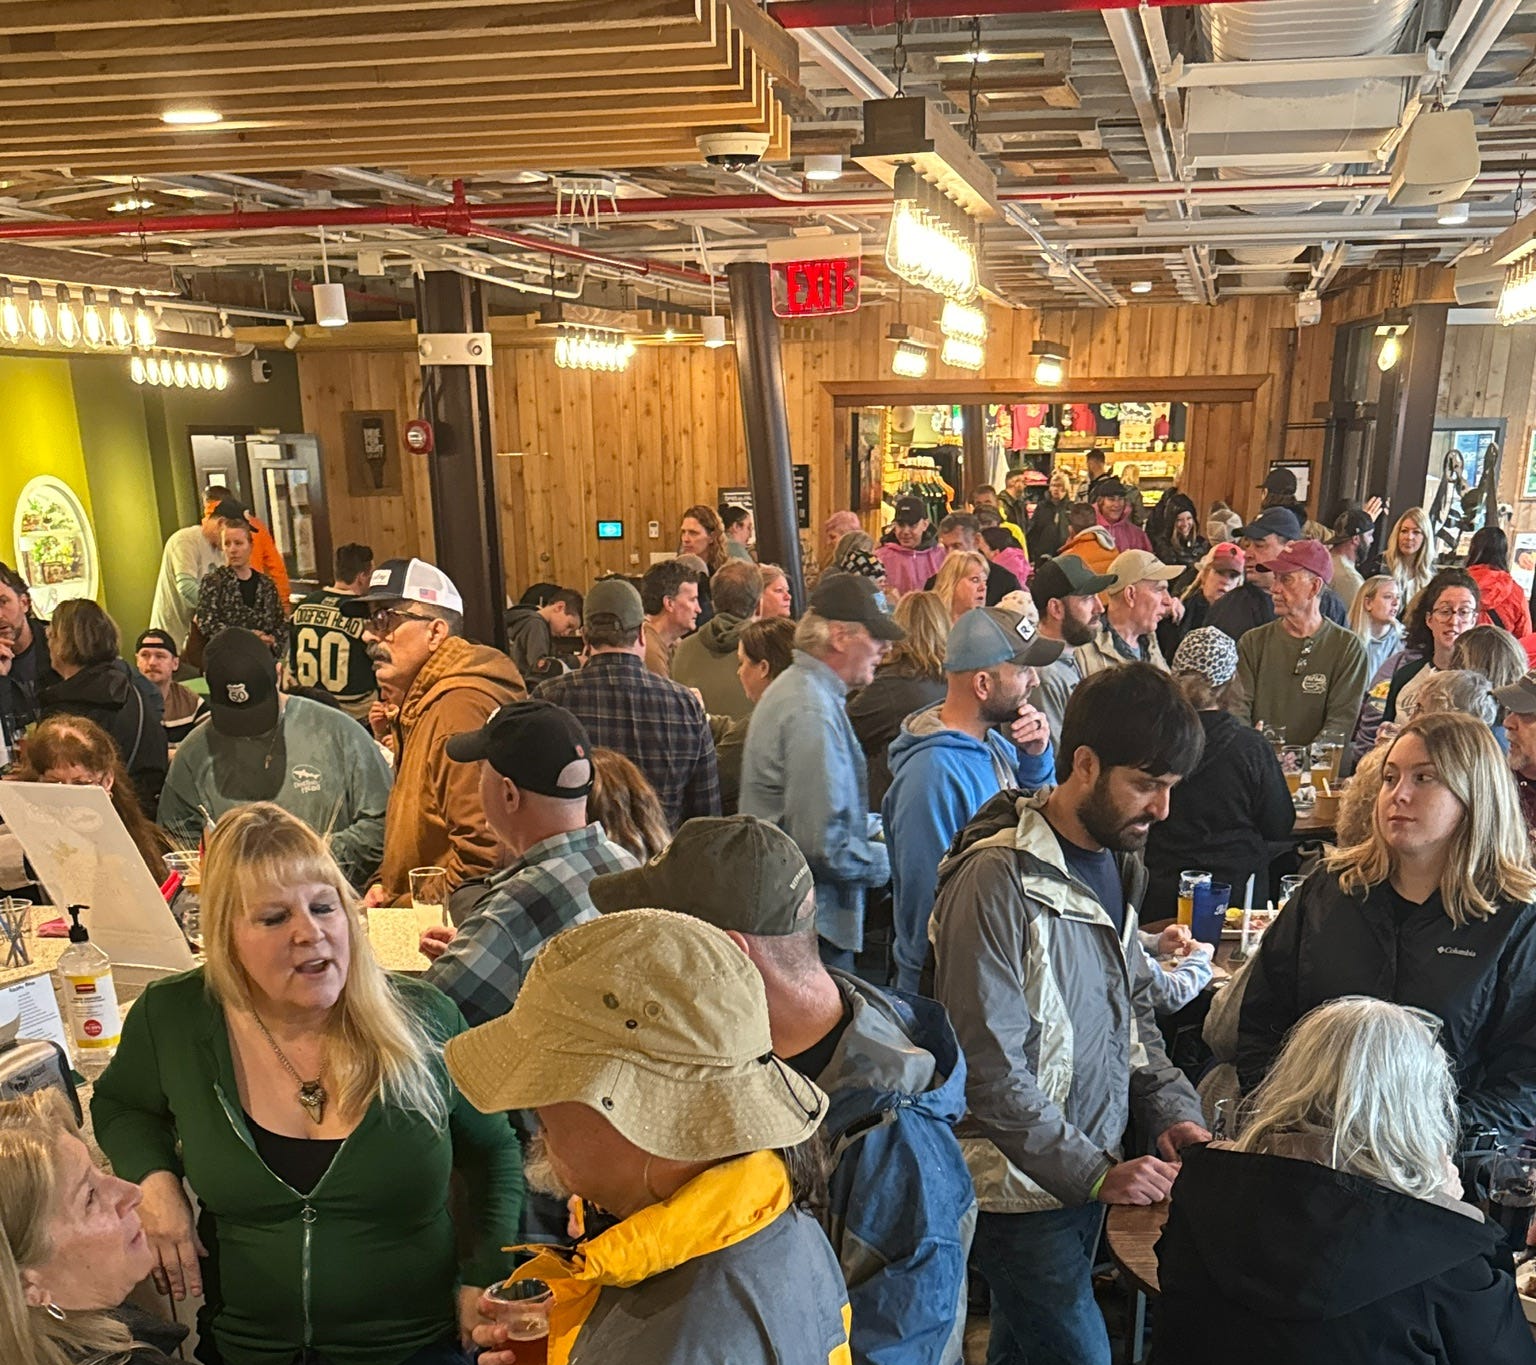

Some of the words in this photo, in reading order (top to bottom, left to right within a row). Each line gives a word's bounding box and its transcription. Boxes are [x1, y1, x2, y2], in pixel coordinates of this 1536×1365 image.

[787, 261, 848, 311] EXIT
[296, 607, 331, 627] DOGFISH
[332, 610, 361, 635] HEAD
[296, 627, 350, 692] 60
[231, 691, 247, 701] 50
[1444, 946, 1476, 957] Columbia
